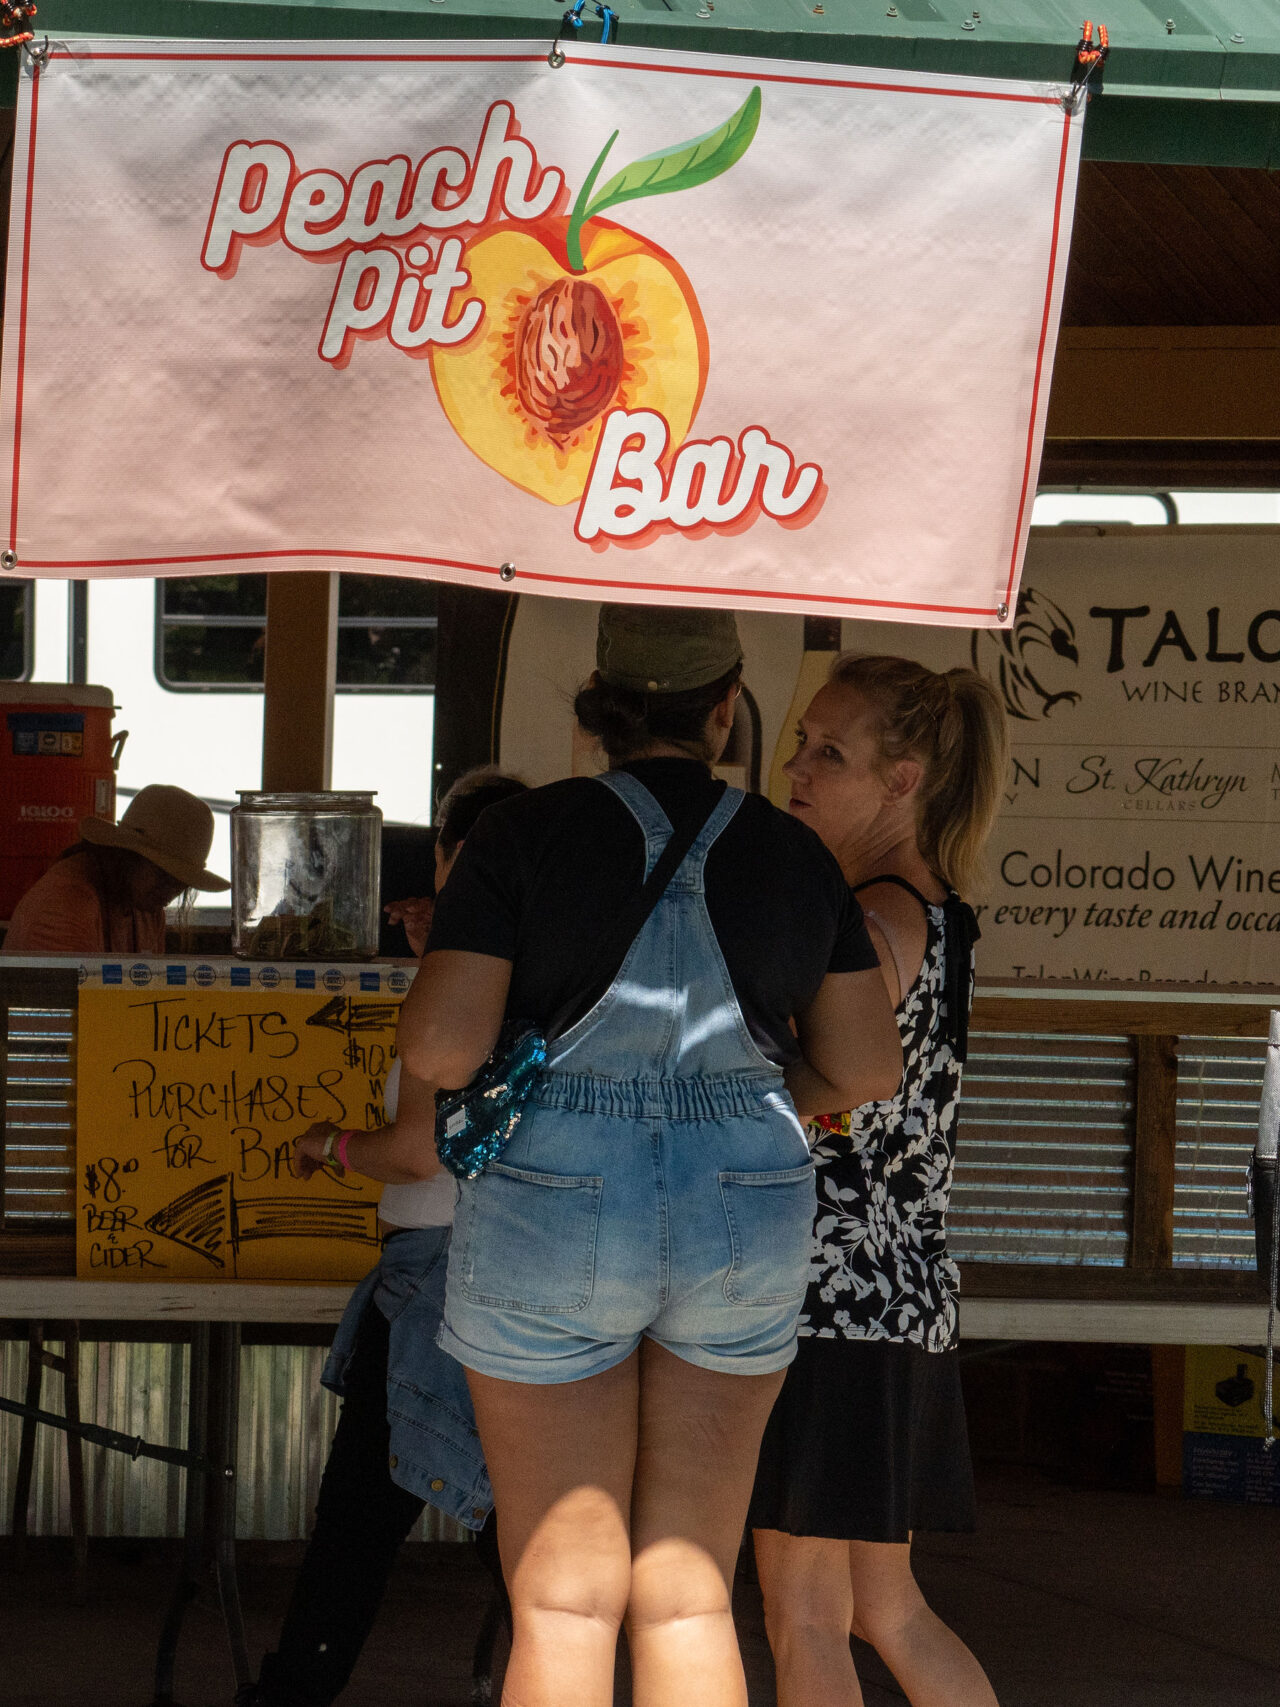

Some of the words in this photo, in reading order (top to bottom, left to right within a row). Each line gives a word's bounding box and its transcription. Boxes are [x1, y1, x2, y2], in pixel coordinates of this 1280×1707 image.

[575, 407, 824, 545] Bar
[1122, 680, 1203, 704] WINE
[1066, 755, 1117, 794] St.
[1125, 757, 1249, 809] Kathryn
[1123, 800, 1196, 811] CELLARS
[1000, 849, 1175, 891] Colorado
[994, 903, 1077, 938] every
[1083, 902, 1153, 928] taste
[1159, 900, 1223, 930] and
[128, 998, 300, 1059] TICKETS
[113, 1058, 347, 1125] PURCHASES
[82, 1203, 144, 1233] BEER
[90, 1239, 168, 1269] CIDER
